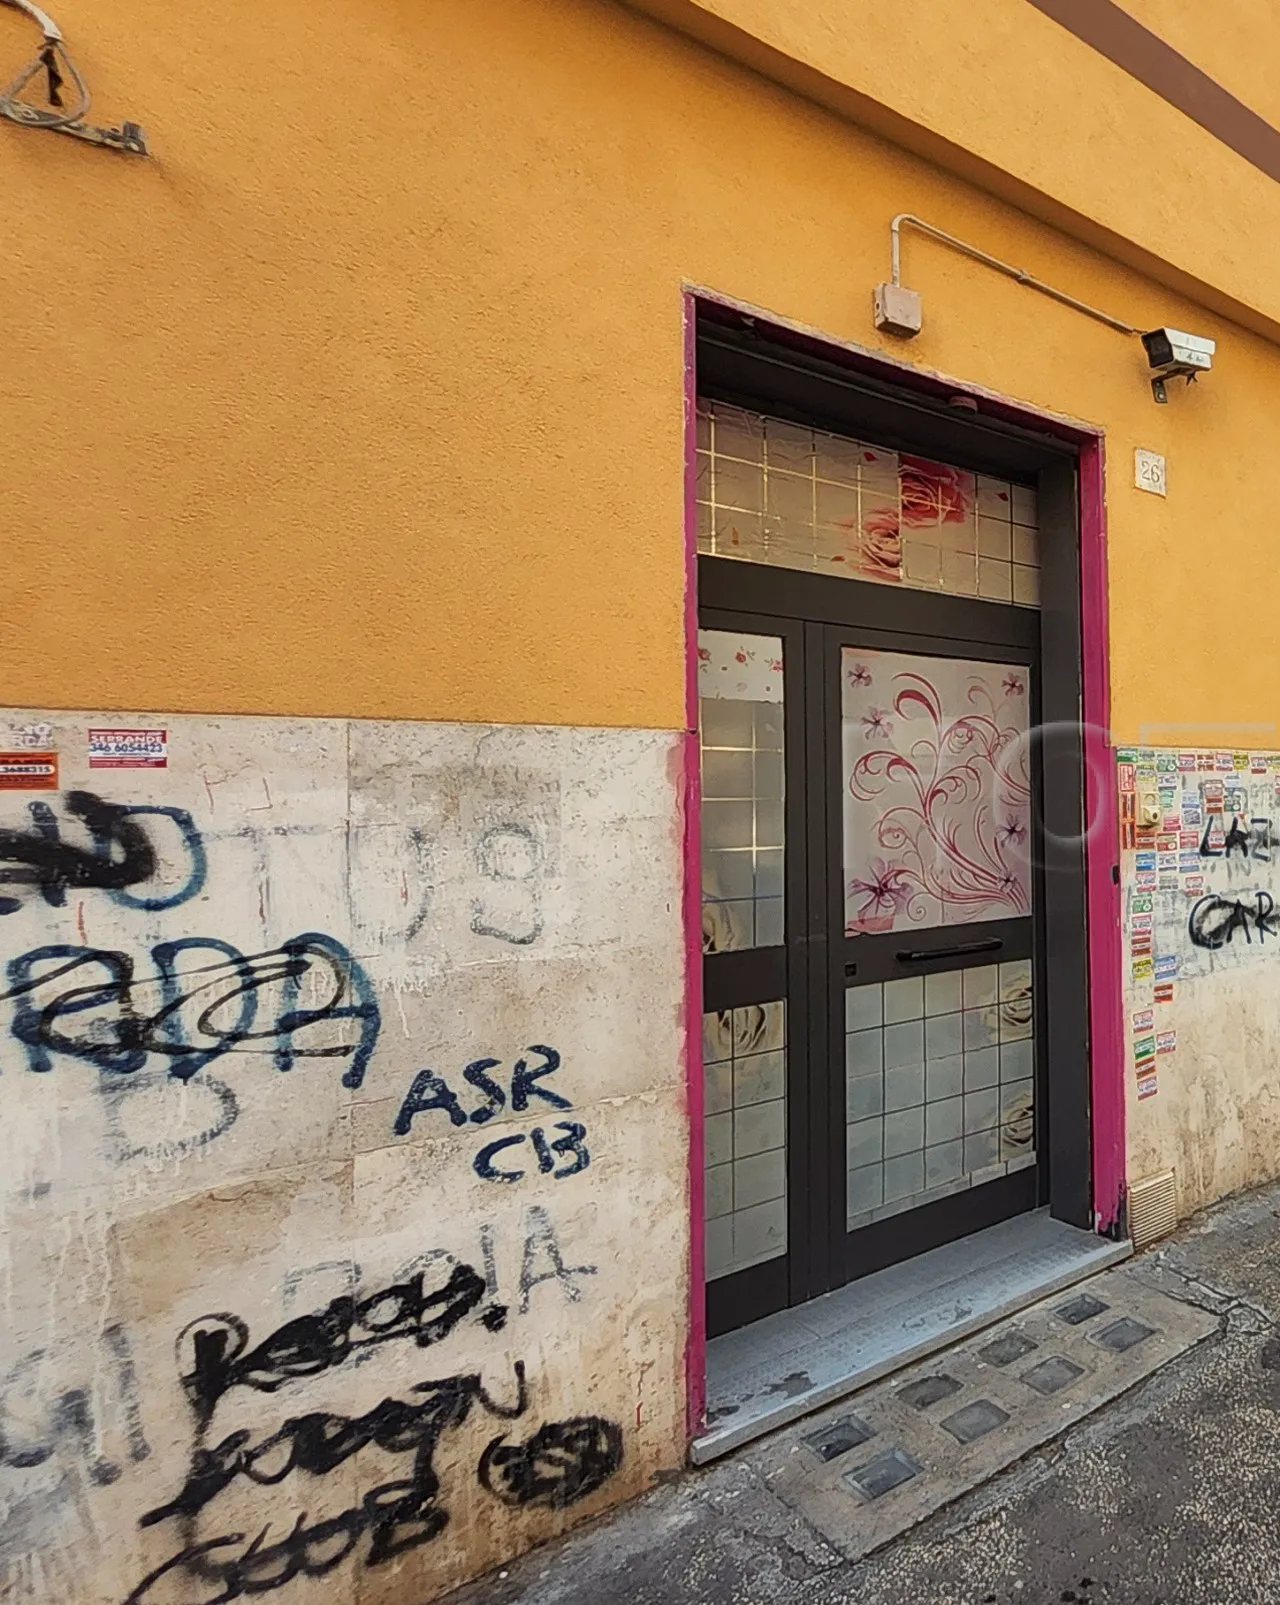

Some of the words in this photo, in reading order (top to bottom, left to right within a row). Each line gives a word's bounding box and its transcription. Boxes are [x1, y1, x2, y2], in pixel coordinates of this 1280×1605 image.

[1141, 460, 1160, 483] 26
[90, 735, 163, 744] SERRANDE
[90, 743, 112, 752] 346
[393, 1044, 573, 1136] ASR
